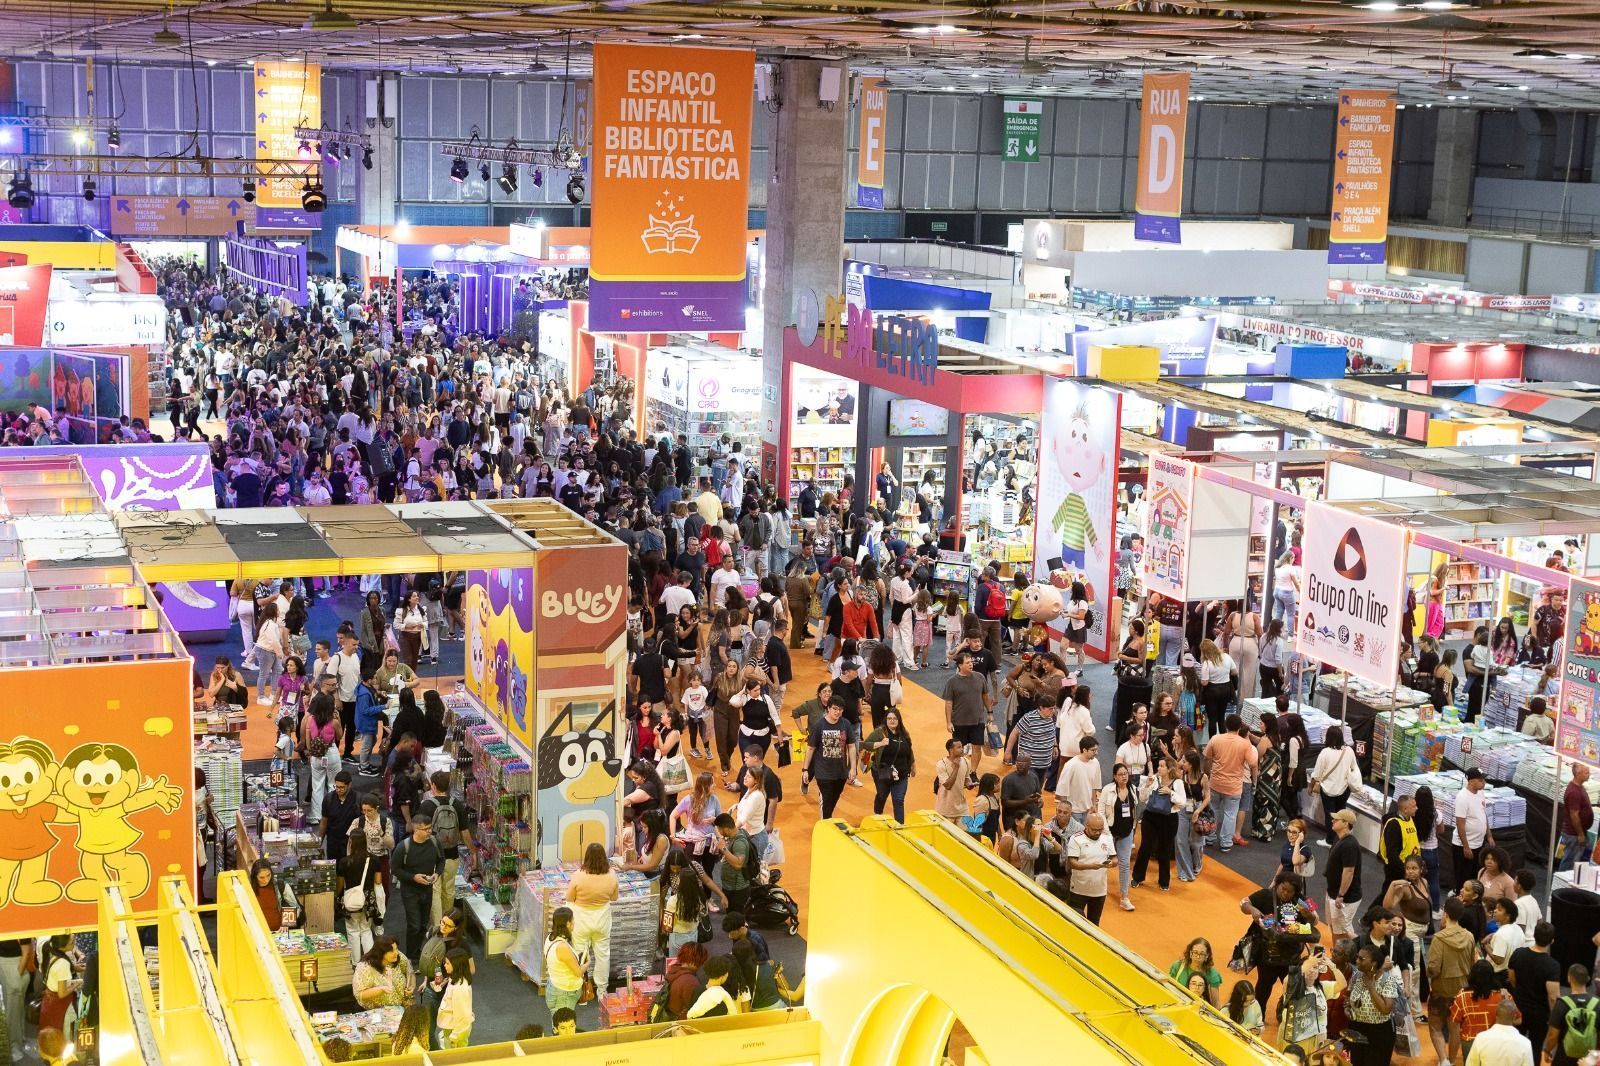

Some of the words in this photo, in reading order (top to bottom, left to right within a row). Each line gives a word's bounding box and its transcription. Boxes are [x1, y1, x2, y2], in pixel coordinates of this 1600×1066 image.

[627, 69, 716, 99] ESPAÇO
[620, 98, 722, 124] INFANTIL
[866, 90, 884, 111] RUA
[1150, 89, 1181, 115] RUA
[1351, 98, 1386, 107] BANHEIROS
[577, 106, 586, 147] G
[1007, 117, 1028, 125] SAÍDA
[1350, 115, 1381, 123] BANHEIRO
[605, 126, 735, 153] BIBLIOTECA
[866, 117, 880, 171] E
[1348, 139, 1373, 149] ESPAÇO
[1148, 124, 1176, 194] D
[1347, 157, 1381, 166] BIBLIOTECA
[1348, 148, 1374, 157] INFANTIL
[604, 153, 741, 181] FANTÁSTICA
[1345, 181, 1378, 190] PAVILHÕES
[1349, 191, 1355, 199] E
[1355, 191, 1360, 199] 4
[1343, 216, 1352, 224] DA
[1344, 206, 1364, 216] PRAÇA
[1364, 206, 1381, 216] ALÉM
[1342, 224, 1361, 233] SHELL
[847, 302, 873, 369] DA
[876, 314, 939, 387] LETRA
[1242, 318, 1286, 336] LIVRARIA
[1288, 327, 1301, 338] DO
[1303, 328, 1364, 350] PROFESSOR
[697, 400, 720, 409] CPAD
[541, 584, 623, 624] BLUEY
[1308, 573, 1345, 617] Grupo
[1348, 587, 1364, 619] On
[1366, 589, 1388, 628] line
[1566, 660, 1588, 681] CUTE
[1588, 667, 1597, 684] &
